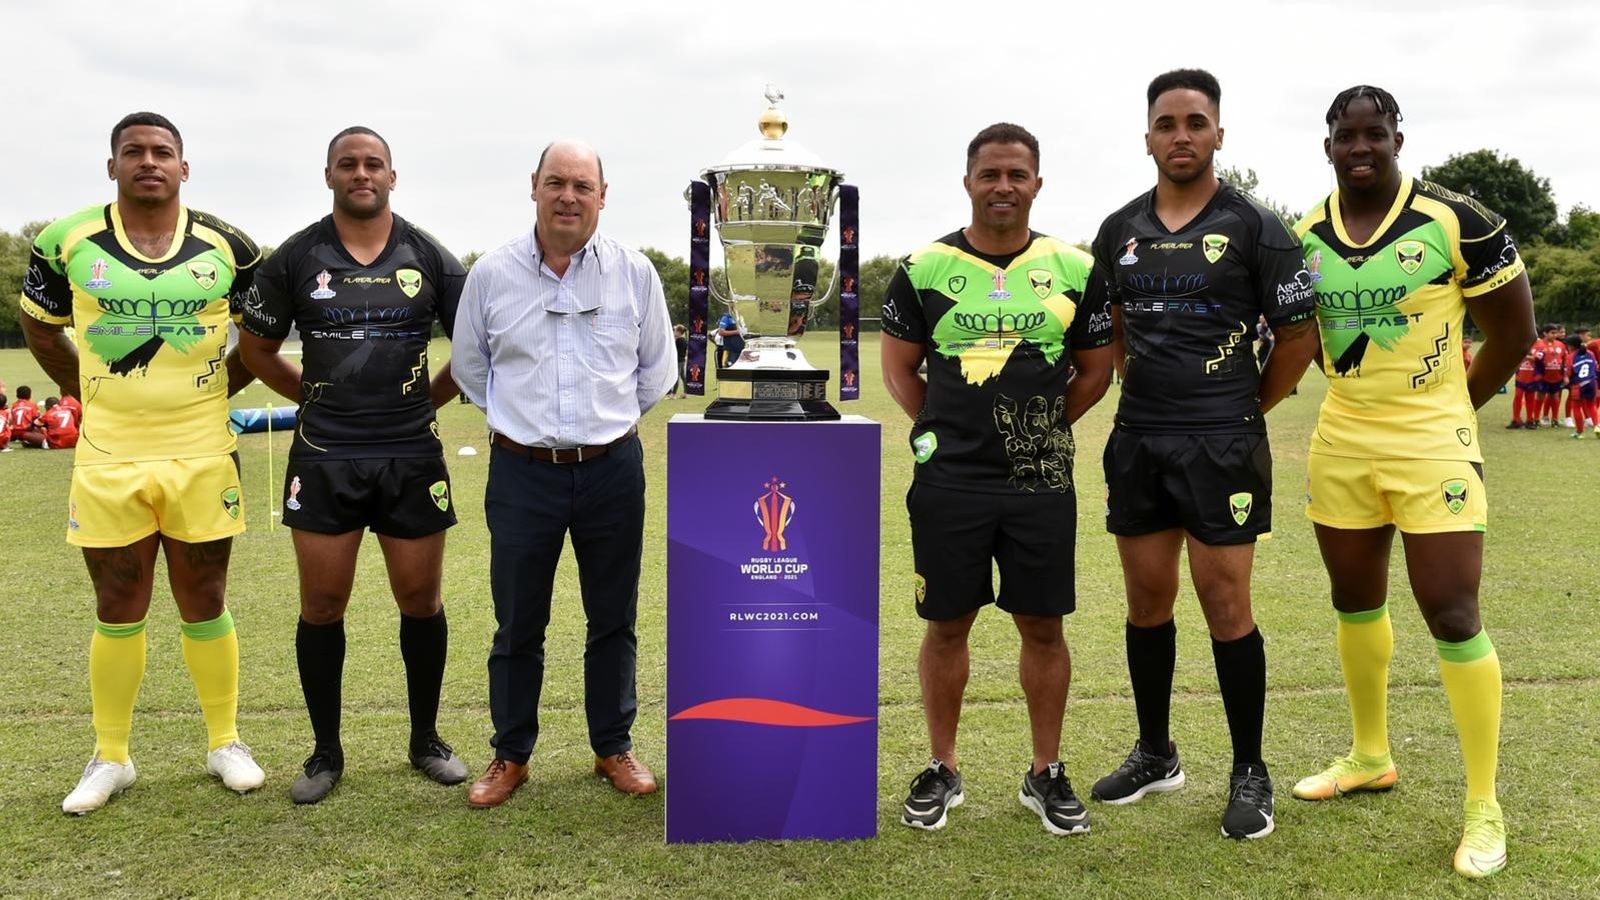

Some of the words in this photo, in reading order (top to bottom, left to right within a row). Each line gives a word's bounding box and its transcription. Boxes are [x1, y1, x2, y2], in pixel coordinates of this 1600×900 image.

[1277, 281, 1299, 296] Age
[1166, 302, 1222, 314] FAST
[1362, 312, 1424, 329] FAST
[87, 325, 153, 336] SMILE
[157, 325, 218, 336] FAST
[311, 330, 365, 340] SMILE
[16, 409, 24, 425] 1
[57, 412, 70, 428] 7
[740, 564, 782, 574] WORLD
[784, 564, 809, 574] CUP
[729, 612, 818, 621] RLWC2021.COM
